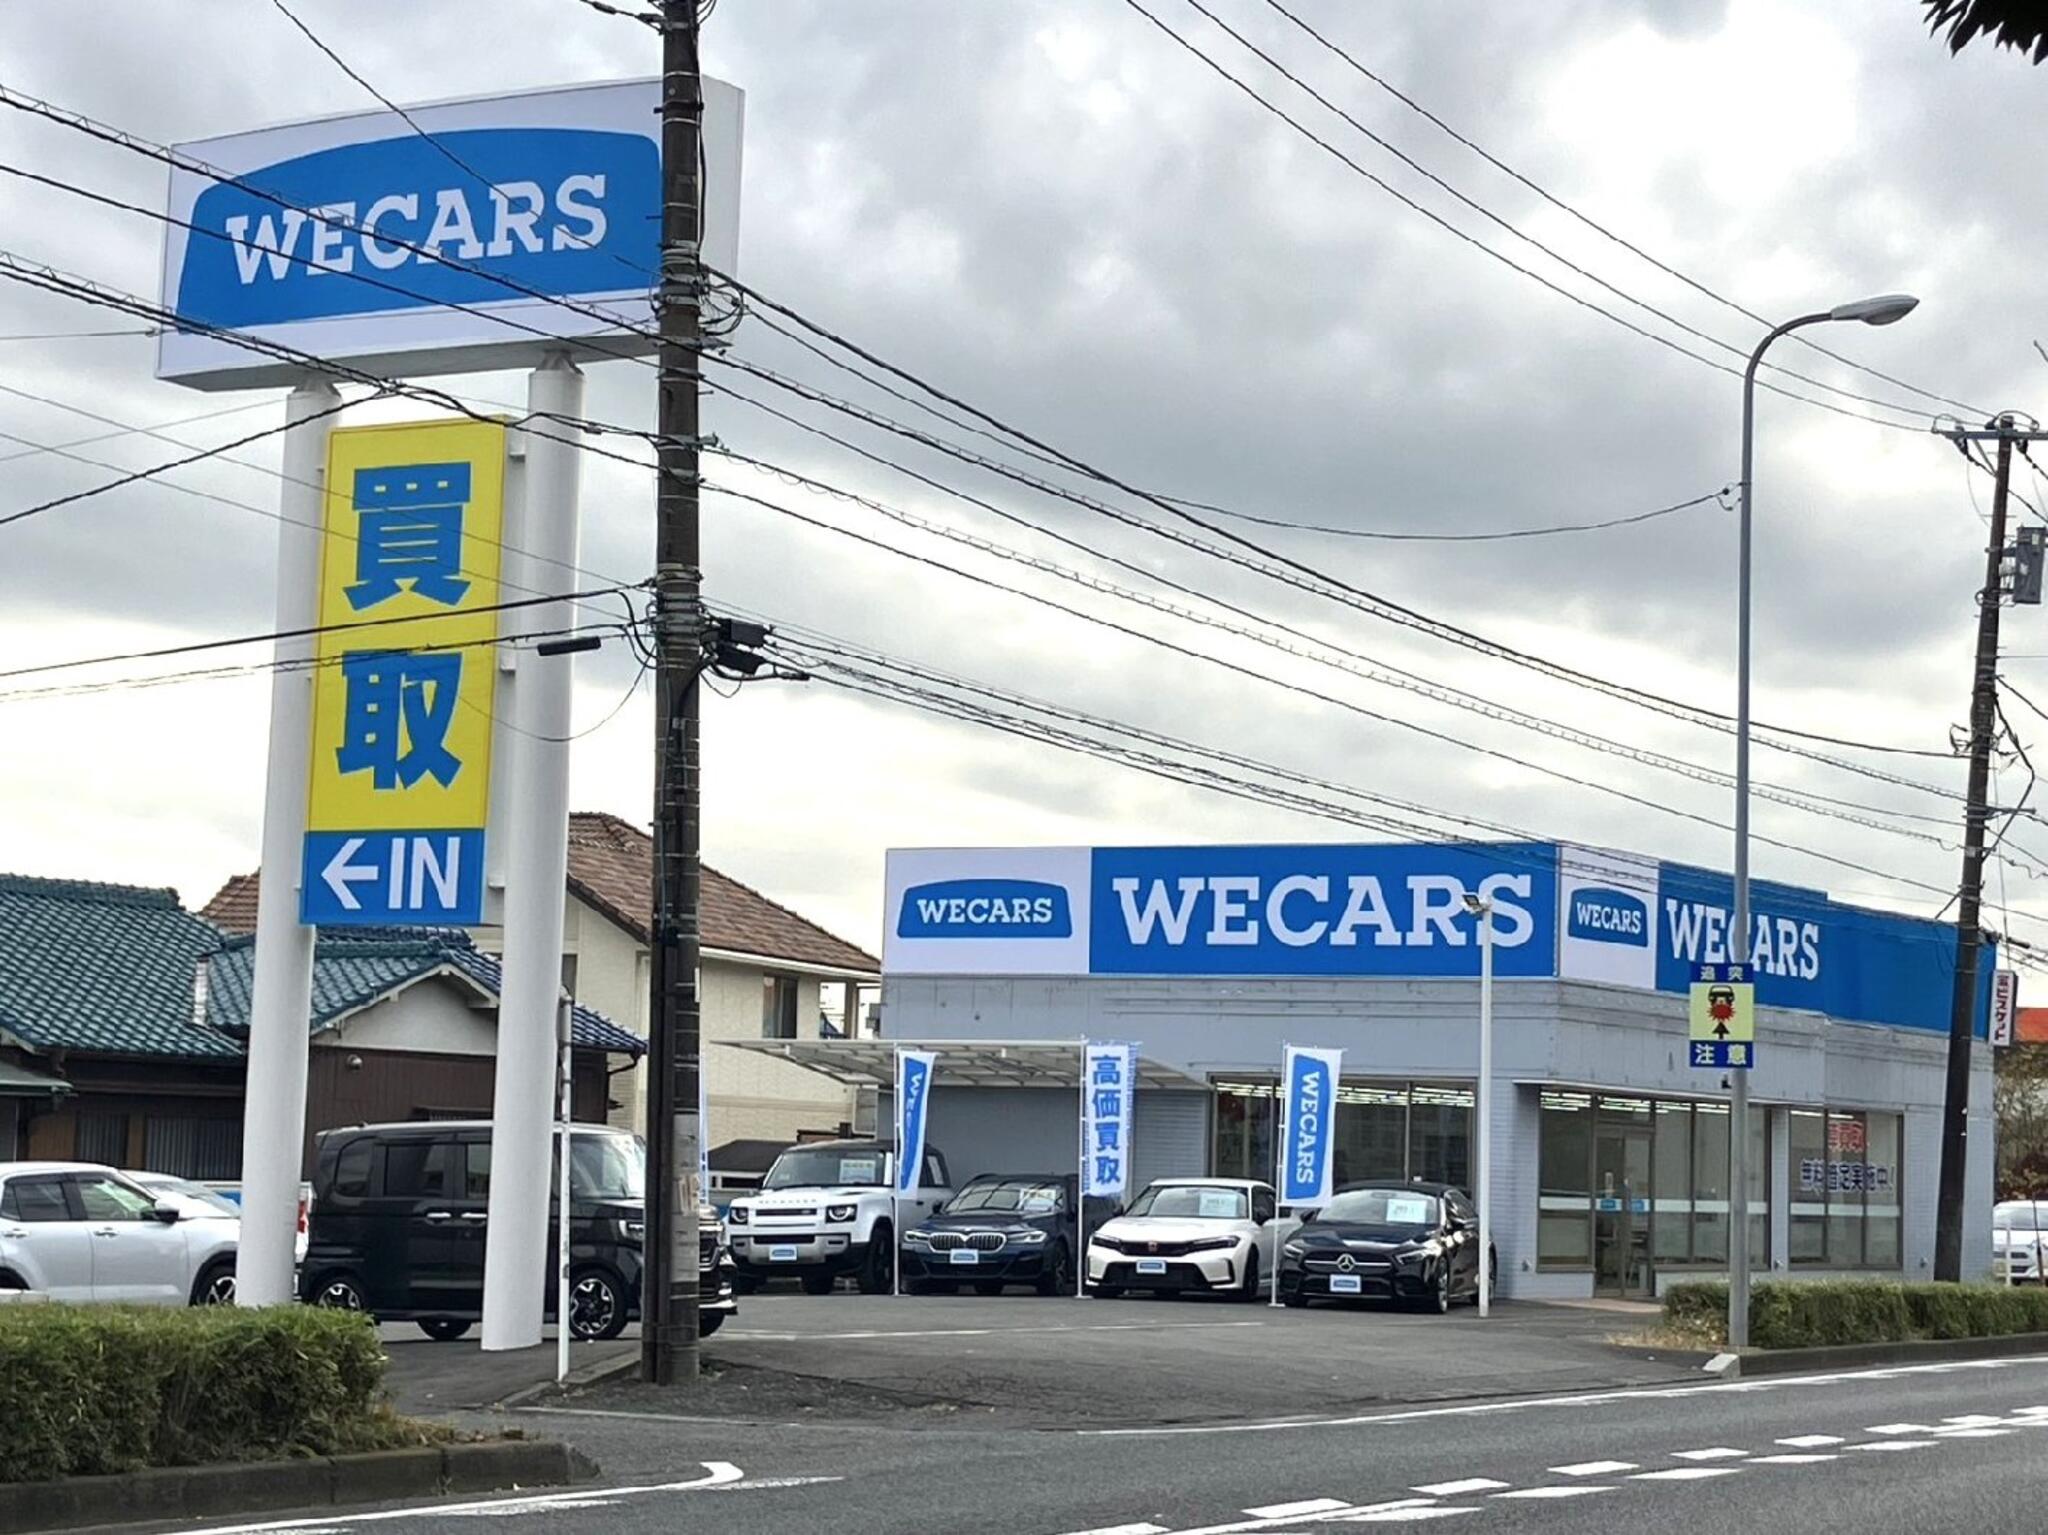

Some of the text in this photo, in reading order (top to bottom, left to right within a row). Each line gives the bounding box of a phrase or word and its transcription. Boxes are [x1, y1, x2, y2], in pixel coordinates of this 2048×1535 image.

[225, 174, 608, 285] WECARS
[337, 462, 471, 791] 買取
[387, 836, 461, 910] IN
[917, 897, 1052, 923] WECARS
[1112, 873, 1534, 948] WECARS
[1576, 902, 1642, 935] WECARS
[1091, 1054, 1121, 1185] 高価買取
[1295, 1071, 1320, 1185] WECARS
